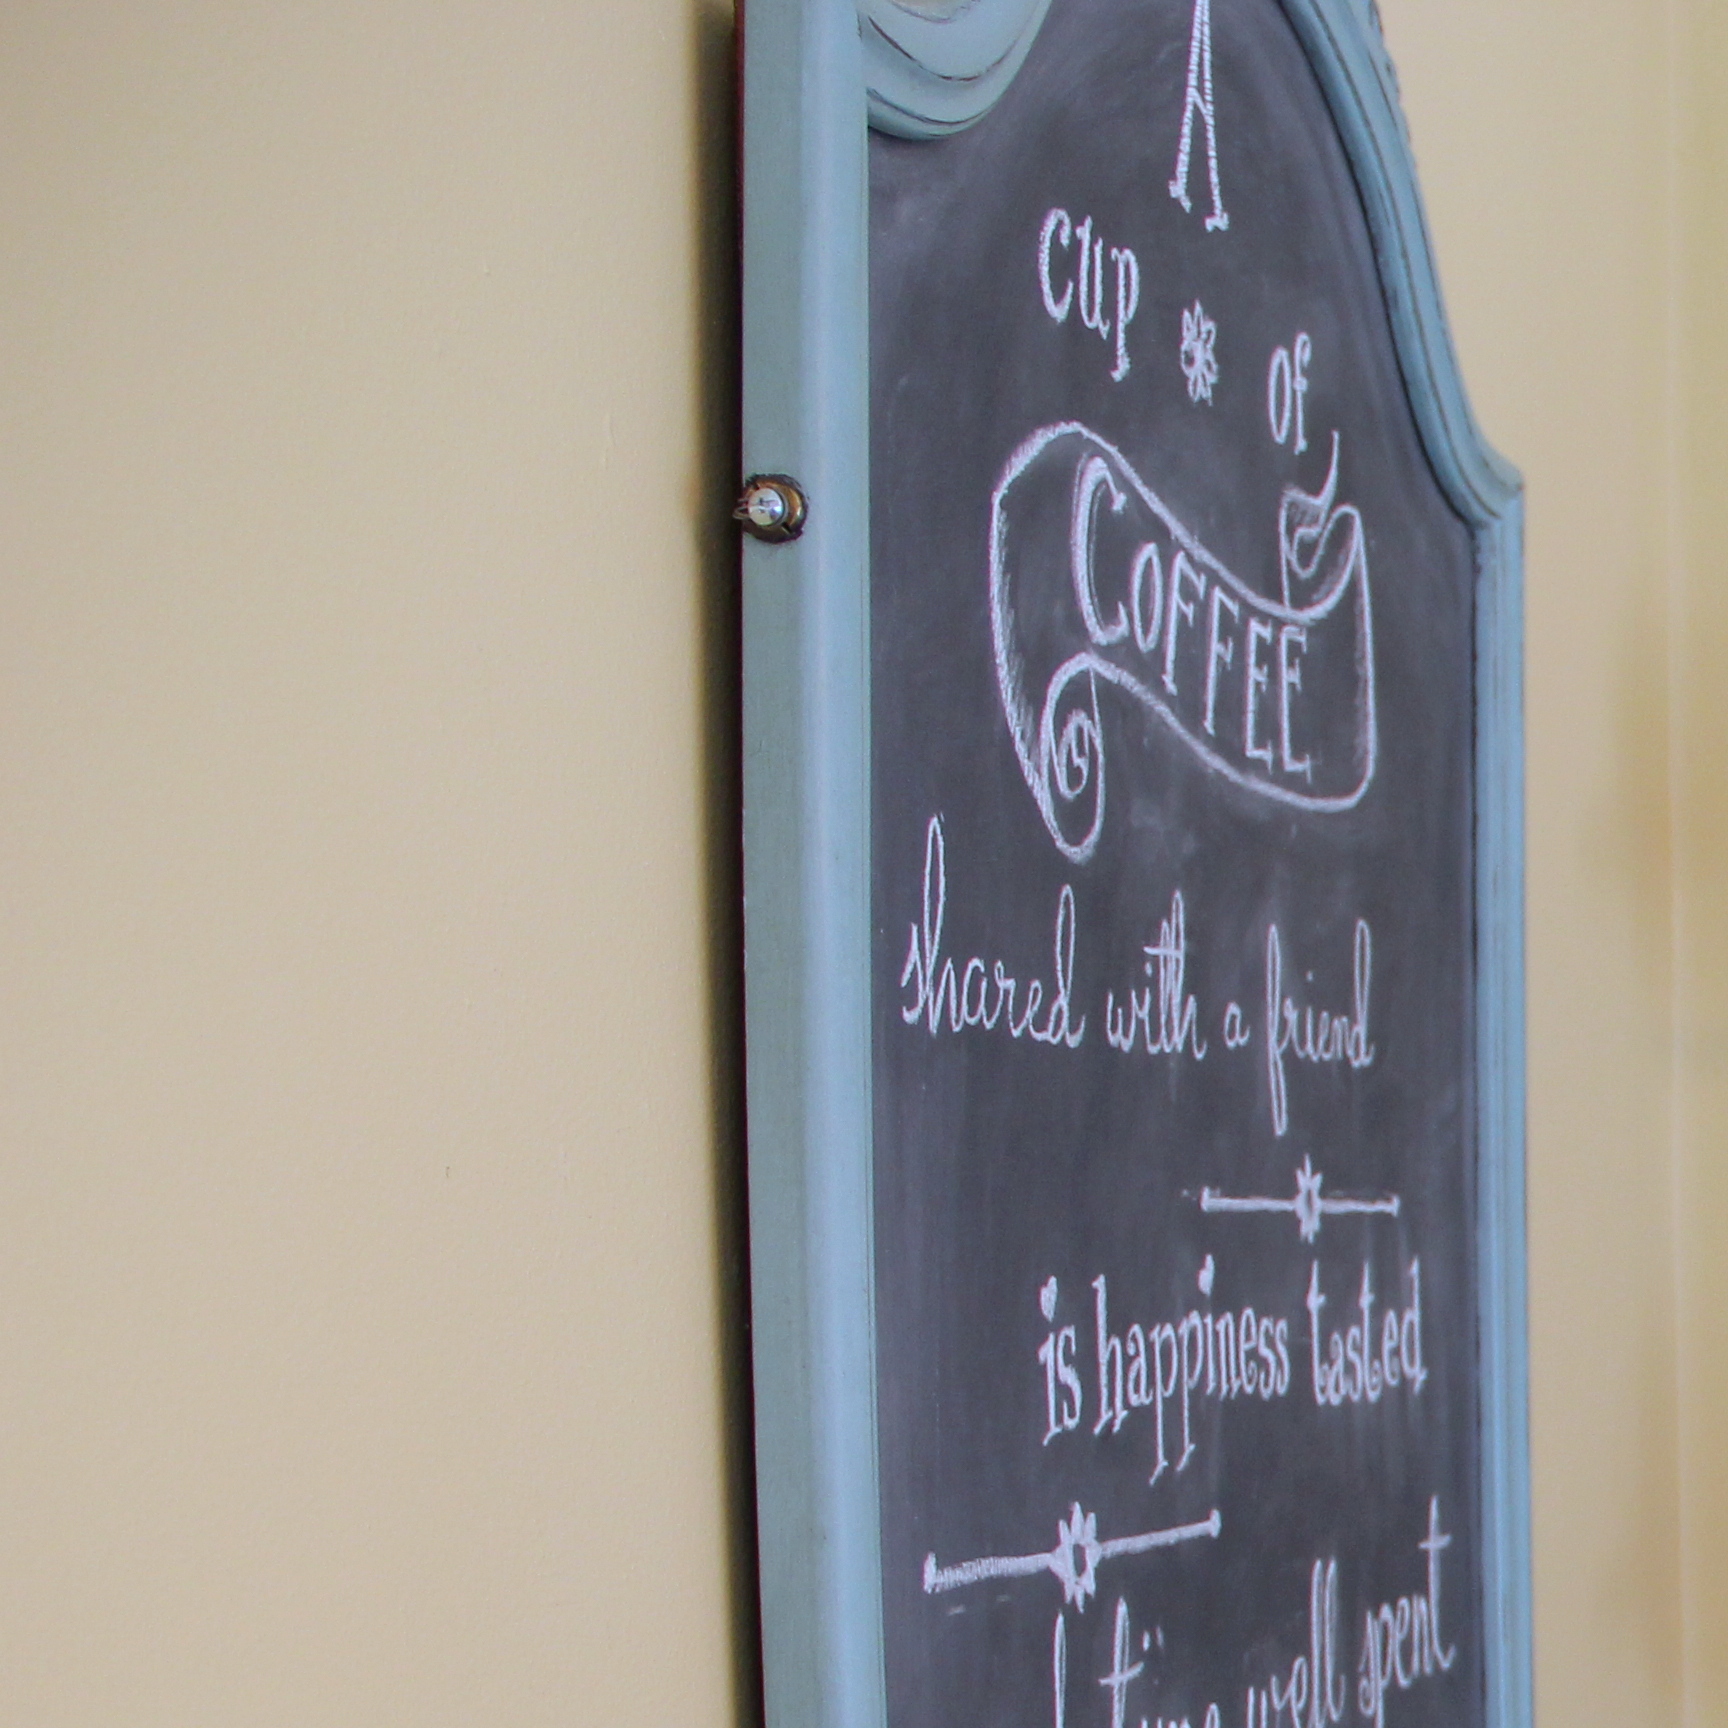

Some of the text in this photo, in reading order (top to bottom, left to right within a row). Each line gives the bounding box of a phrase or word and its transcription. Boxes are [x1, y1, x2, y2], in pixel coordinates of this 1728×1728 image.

[1168, 0, 1228, 231] A
[901, 814, 1376, 1137] shared with a friend
[1037, 1254, 1427, 1485] is happiness tasted
